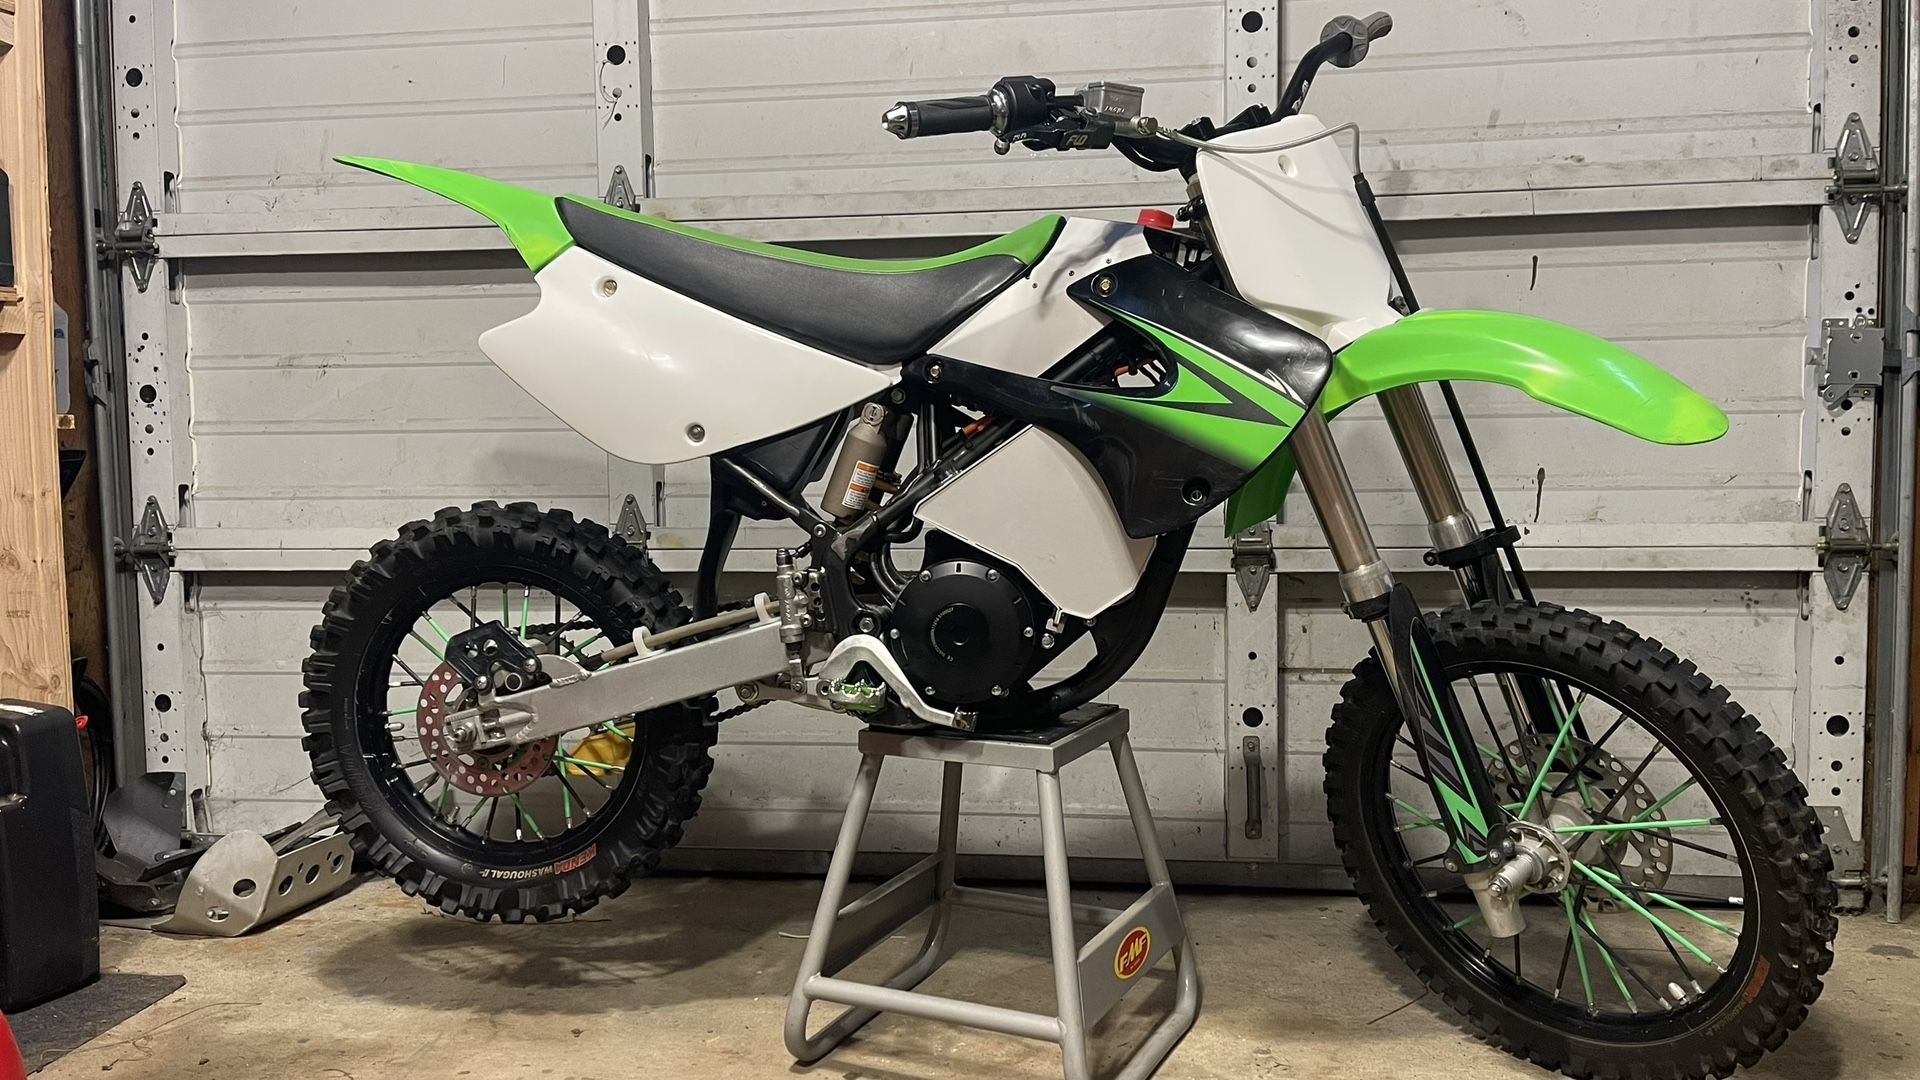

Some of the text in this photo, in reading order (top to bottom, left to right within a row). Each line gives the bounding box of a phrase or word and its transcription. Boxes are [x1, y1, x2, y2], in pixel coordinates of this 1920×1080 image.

[1065, 134, 1089, 146] FLO
[553, 842, 597, 875] KENDA
[490, 864, 553, 880] WASHOUGAL
[1119, 933, 1147, 973] FMF
